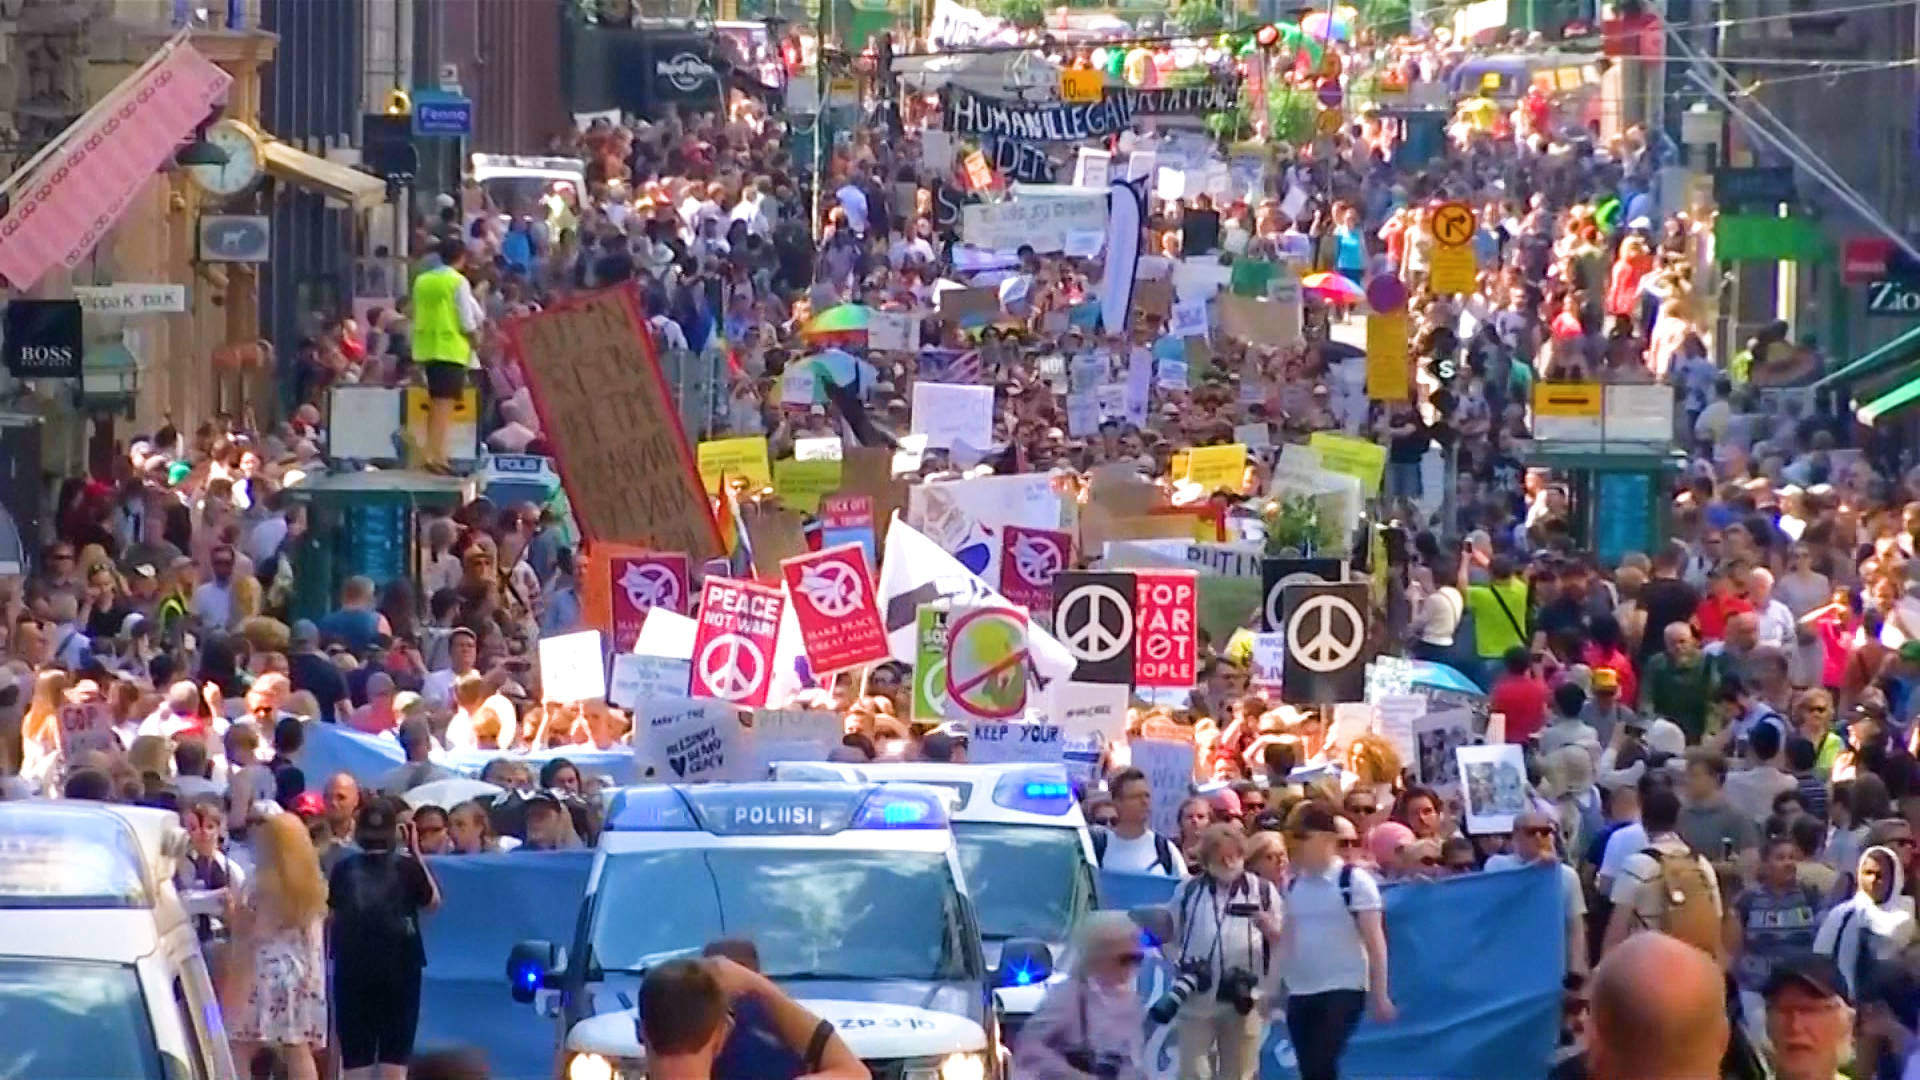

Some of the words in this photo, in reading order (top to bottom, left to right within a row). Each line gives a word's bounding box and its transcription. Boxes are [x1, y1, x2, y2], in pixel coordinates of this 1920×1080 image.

[22, 346, 72, 361] BOSS
[1439, 360, 1455, 378] S
[708, 586, 780, 620] PEACE
[1136, 583, 1192, 606] TOP
[704, 611, 734, 628] NOT
[736, 615, 776, 639] WAR!
[807, 626, 838, 640] MAKE
[840, 616, 875, 633] PEACE
[1136, 662, 1191, 679] OPLE
[974, 723, 1009, 742] KEEP
[1019, 722, 1059, 744] YOUR
[735, 806, 813, 825] POLIISI
